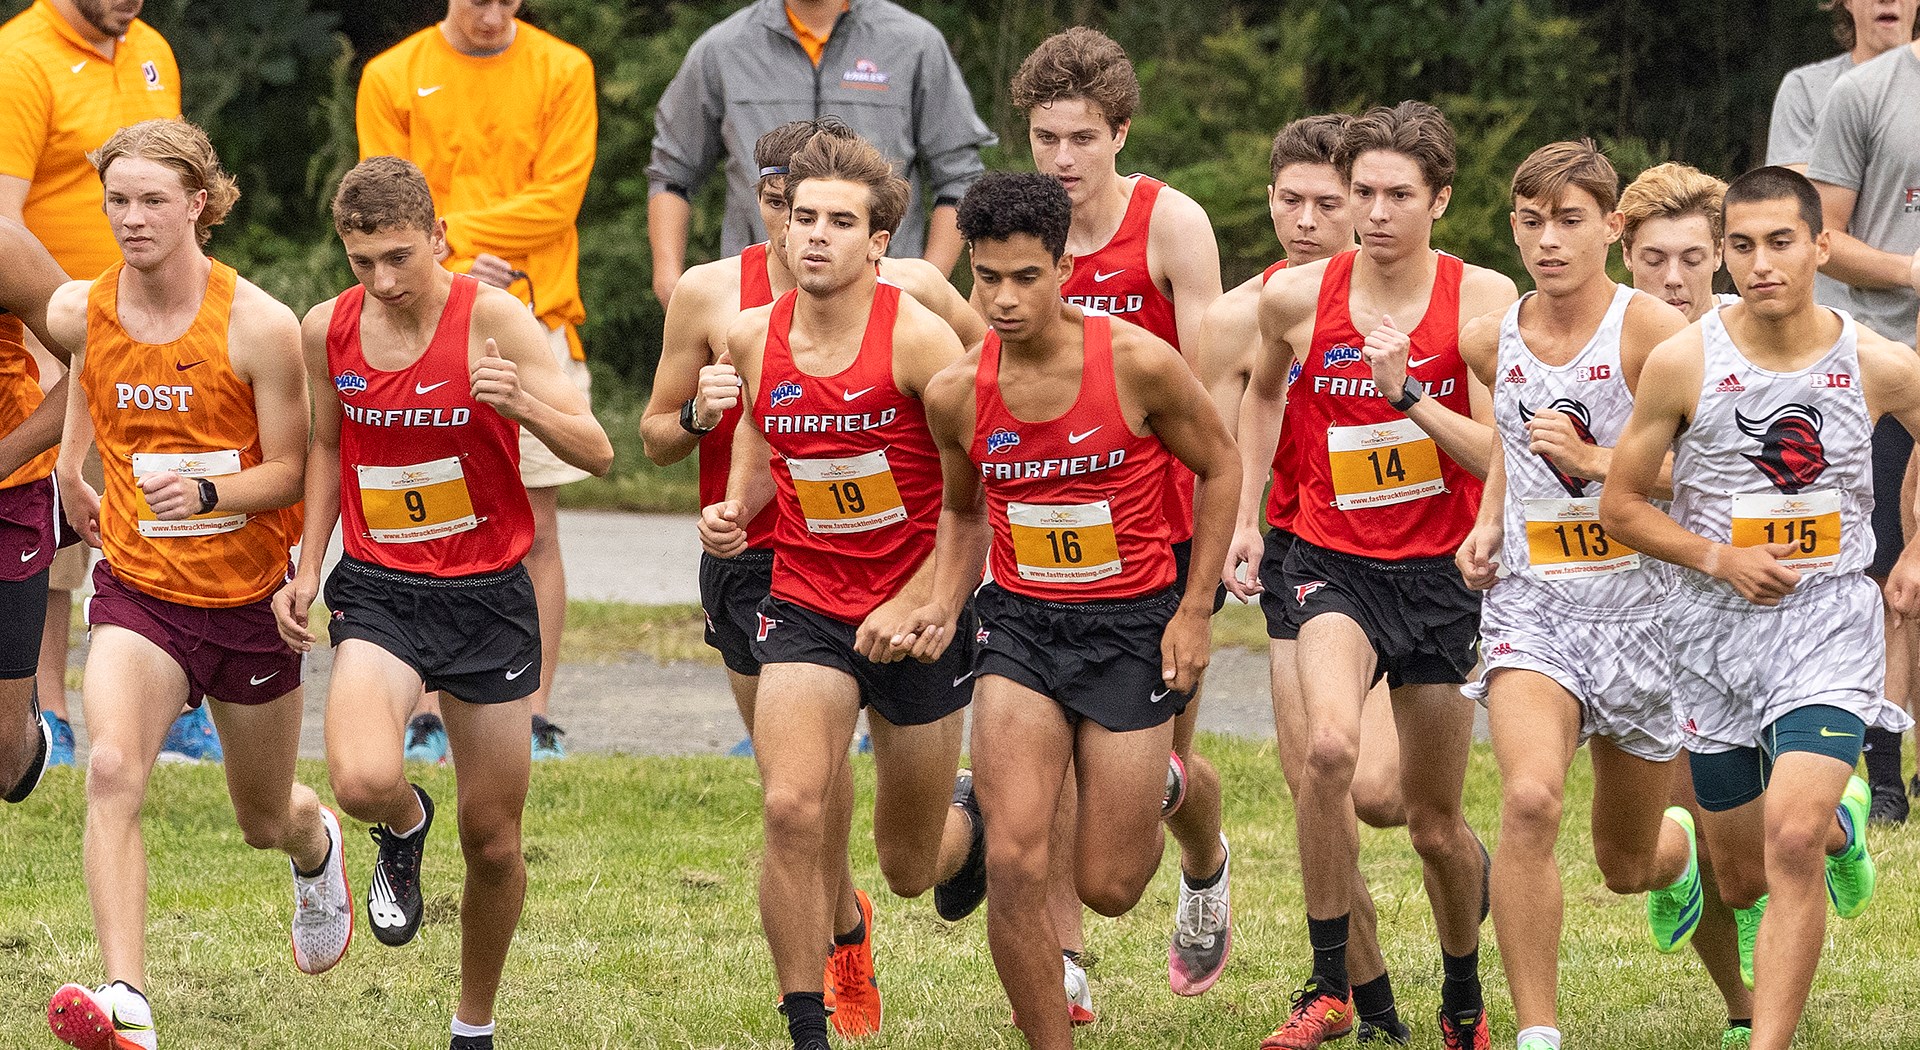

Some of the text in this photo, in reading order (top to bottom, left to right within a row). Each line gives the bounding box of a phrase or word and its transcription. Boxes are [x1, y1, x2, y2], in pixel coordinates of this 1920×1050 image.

[1060, 295, 1143, 314] FIELD
[1324, 347, 1361, 369] MAAC
[335, 374, 367, 392] MAAC
[1313, 376, 1455, 398] FAIRLD
[1715, 384, 1745, 392] adidas
[115, 383, 193, 412] POST
[771, 384, 802, 408] MAAC
[340, 401, 471, 428] AIRFIELD
[763, 408, 897, 434] FAIRFIELD
[987, 432, 1020, 455] MAAC
[980, 449, 1126, 480] FAIRFIELD
[1368, 448, 1406, 485] 14
[404, 490, 427, 522] 9
[828, 482, 865, 514] 19
[1350, 485, 1436, 505] www.fasttracktiming.com
[152, 520, 239, 532] www.fasttracktiming.com
[383, 521, 468, 539] www.fasttracktiming.com
[818, 513, 898, 529] www.fasttracktiming.com
[1046, 530, 1082, 563] 16
[1554, 523, 1609, 557] 113
[1764, 519, 1817, 553] 115
[1029, 566, 1112, 579] www.fasttracktiming.com
[1544, 560, 1631, 575] www.fasttracktiming.com
